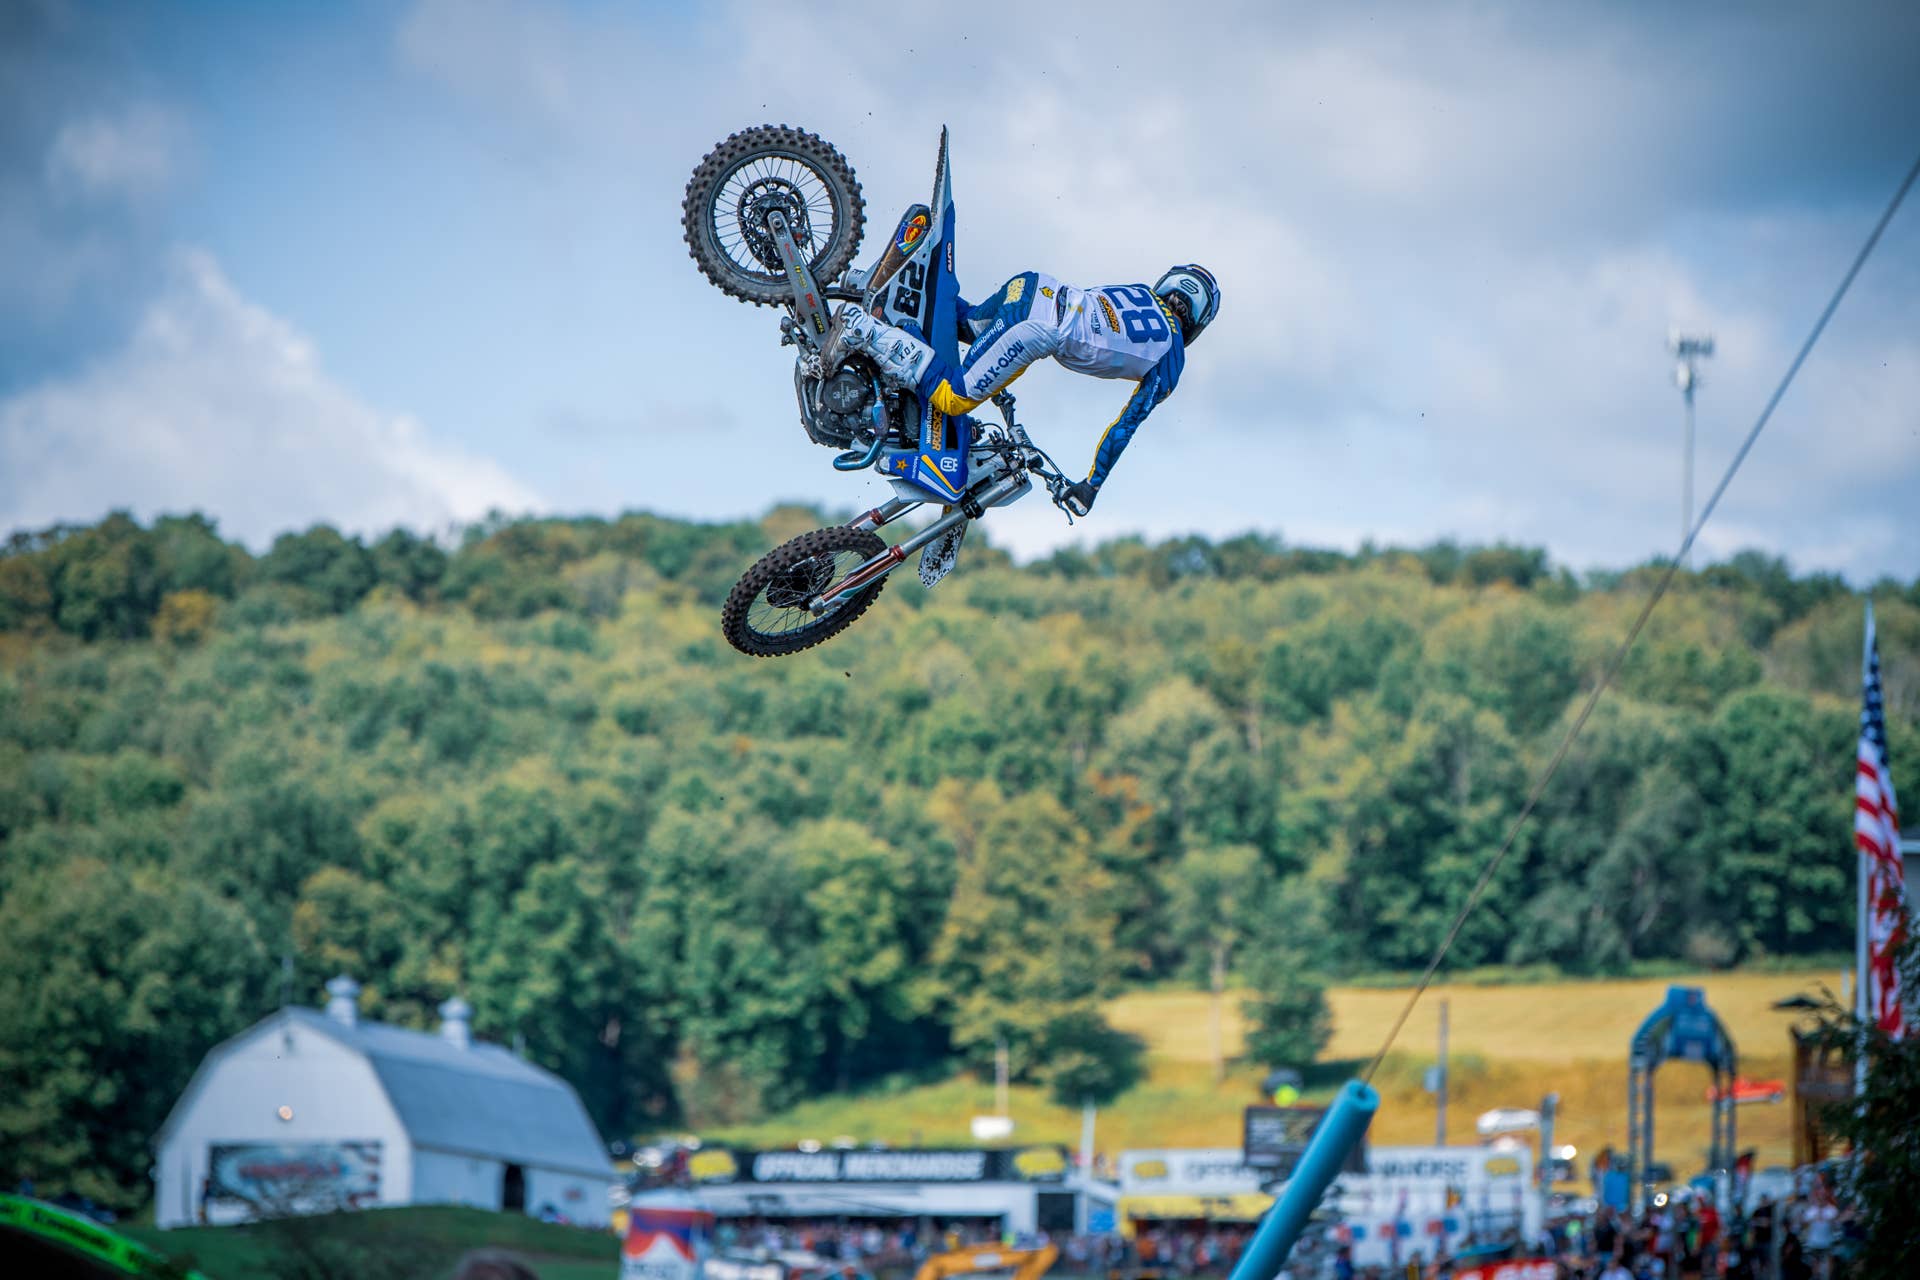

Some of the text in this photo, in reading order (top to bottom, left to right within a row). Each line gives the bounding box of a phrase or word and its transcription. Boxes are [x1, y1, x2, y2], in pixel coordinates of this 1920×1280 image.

[893, 260, 925, 319] 28
[1101, 286, 1170, 343] 28
[899, 341, 916, 361] FOX
[974, 339, 1025, 392] MOTO-X FOX
[752, 1150, 987, 1182] OFFICIAL MERCHANDISE
